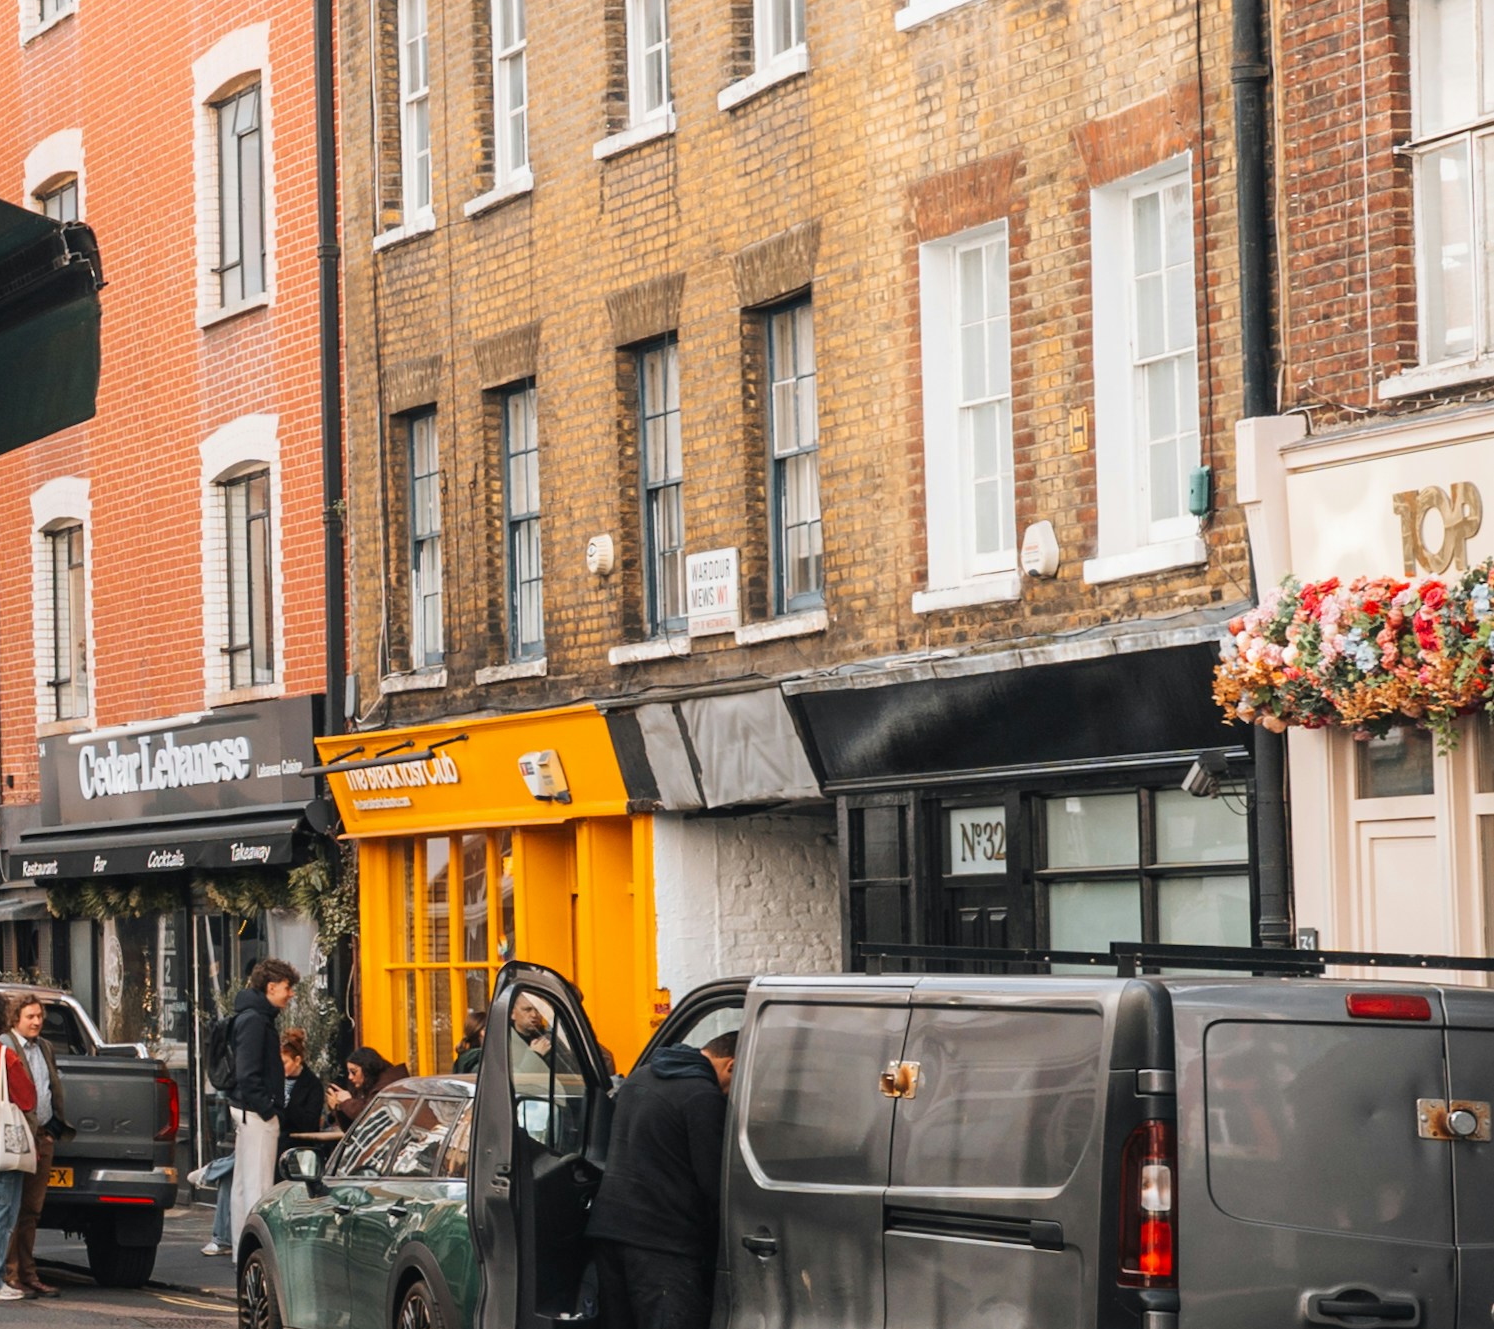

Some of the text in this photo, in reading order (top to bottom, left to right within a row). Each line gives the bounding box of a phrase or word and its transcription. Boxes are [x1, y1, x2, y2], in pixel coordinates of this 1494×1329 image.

[1392, 481, 1484, 577] TOP
[691, 558, 731, 582] WARDOUR
[691, 584, 728, 608] MEWS W1
[78, 731, 251, 801] Cedar Lebanese
[426, 749, 459, 785] Club
[147, 849, 185, 870] Cocktails
[230, 842, 271, 864] Takeaway
